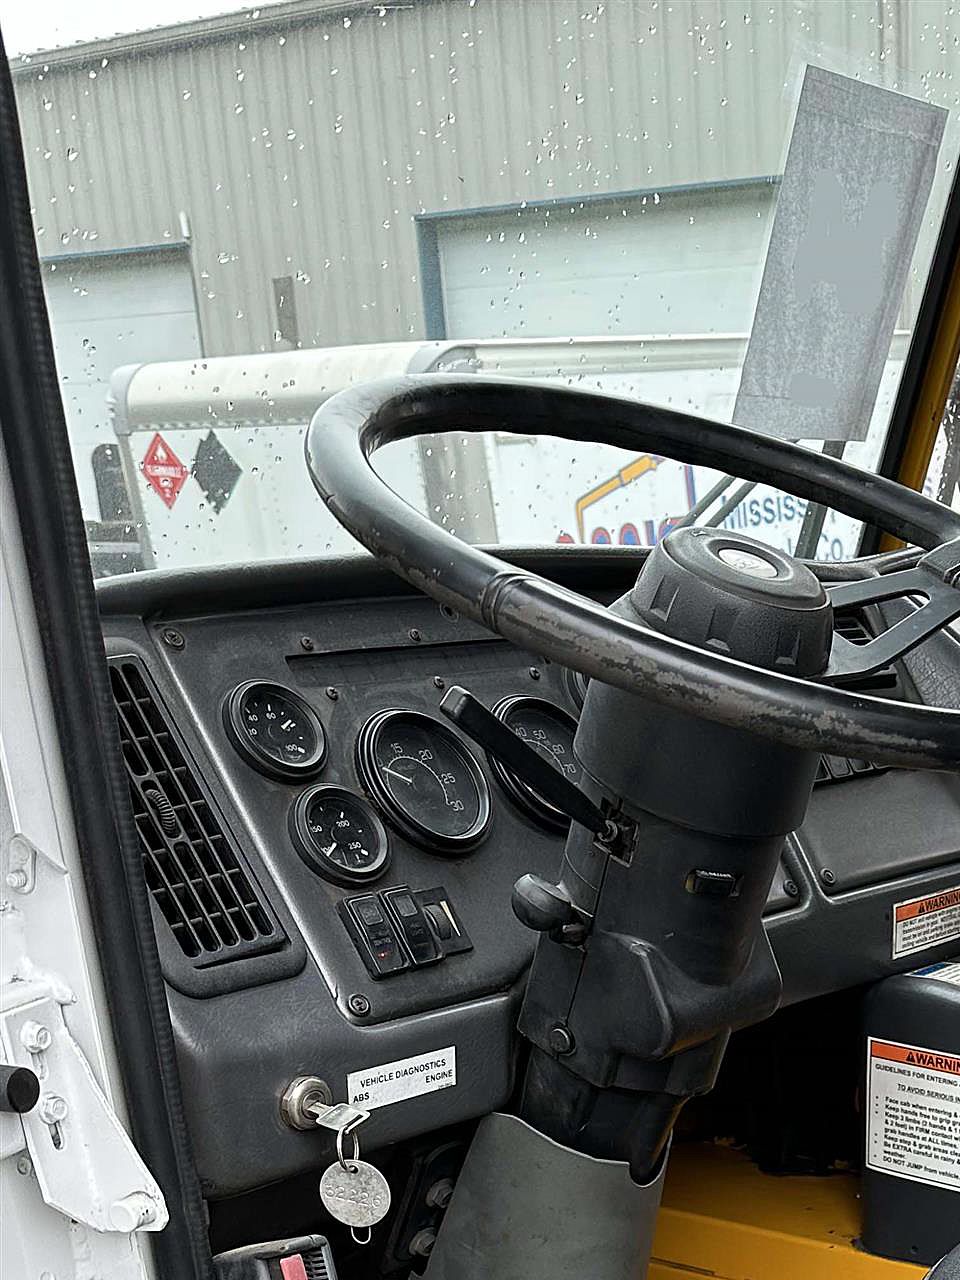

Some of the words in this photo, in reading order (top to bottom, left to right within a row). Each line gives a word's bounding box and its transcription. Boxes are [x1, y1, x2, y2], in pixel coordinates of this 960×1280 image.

[390, 742, 403, 754] 15
[418, 749, 433, 761] 20
[563, 763, 577, 774] 70
[441, 772, 456, 784] 25
[449, 799, 465, 812] 30
[360, 1072, 394, 1088] VEHICLE
[395, 1058, 447, 1079] DIAGNOSTICS
[425, 1069, 453, 1084] ENGINE
[875, 1063, 911, 1076] GUIDELINES
[912, 1071, 925, 1080] FOR
[926, 1074, 957, 1086] ENTERING
[353, 1092, 370, 1103] ABS
[897, 1084, 906, 1092] TO
[906, 1086, 925, 1096] AVOID
[926, 1090, 954, 1101] SERIOUS
[884, 1105, 899, 1114] Keep
[900, 1108, 917, 1117] hands
[919, 1112, 930, 1120] free
[911, 1103, 927, 1111] when
[928, 1107, 952, 1117] entering
[884, 1112, 899, 1121] Keep
[915, 1127, 929, 1135] FIRM
[892, 1144, 911, 1153] EXTRA
[906, 1162, 922, 1171] JUMP
